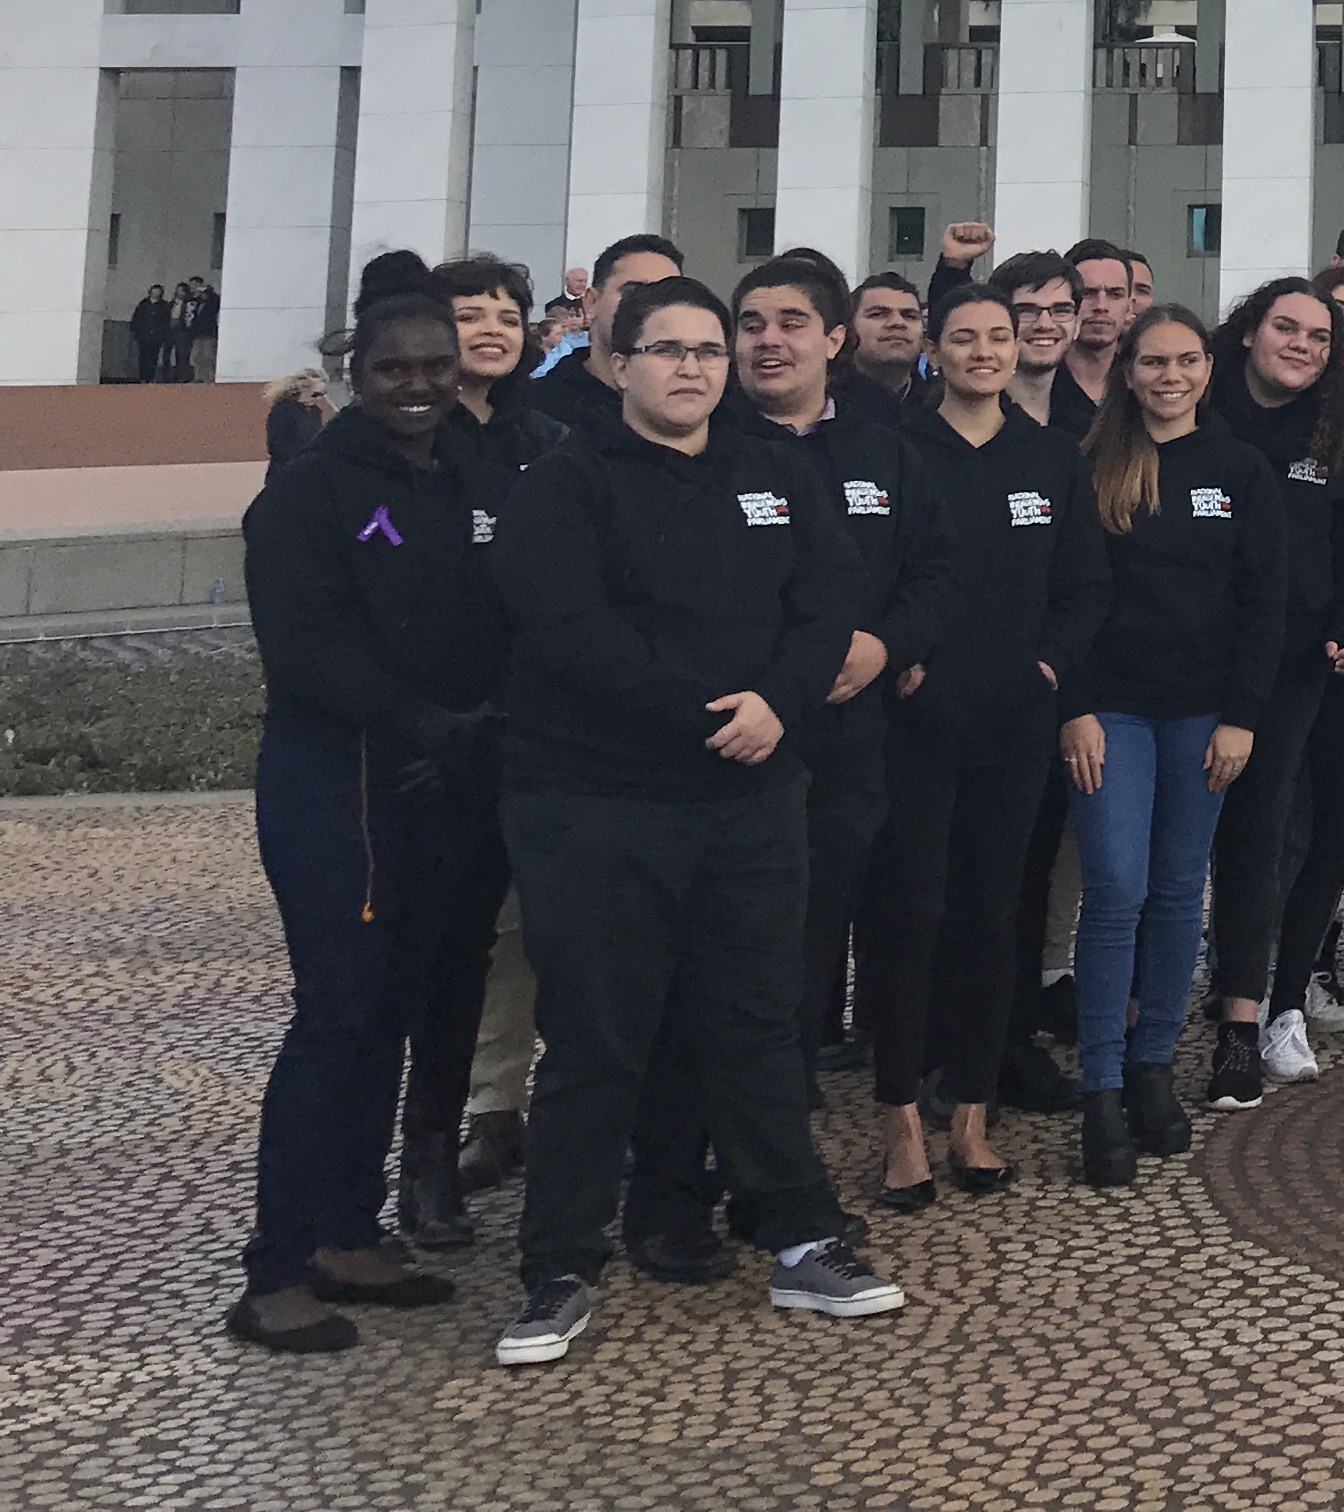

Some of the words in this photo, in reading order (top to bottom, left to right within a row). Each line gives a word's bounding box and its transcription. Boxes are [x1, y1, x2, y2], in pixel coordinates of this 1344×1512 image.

[846, 495, 879, 507] YOUTH
[1193, 501, 1221, 511] YOUTH
[743, 507, 777, 518] YOUTH
[1011, 506, 1041, 518] YOUTH
